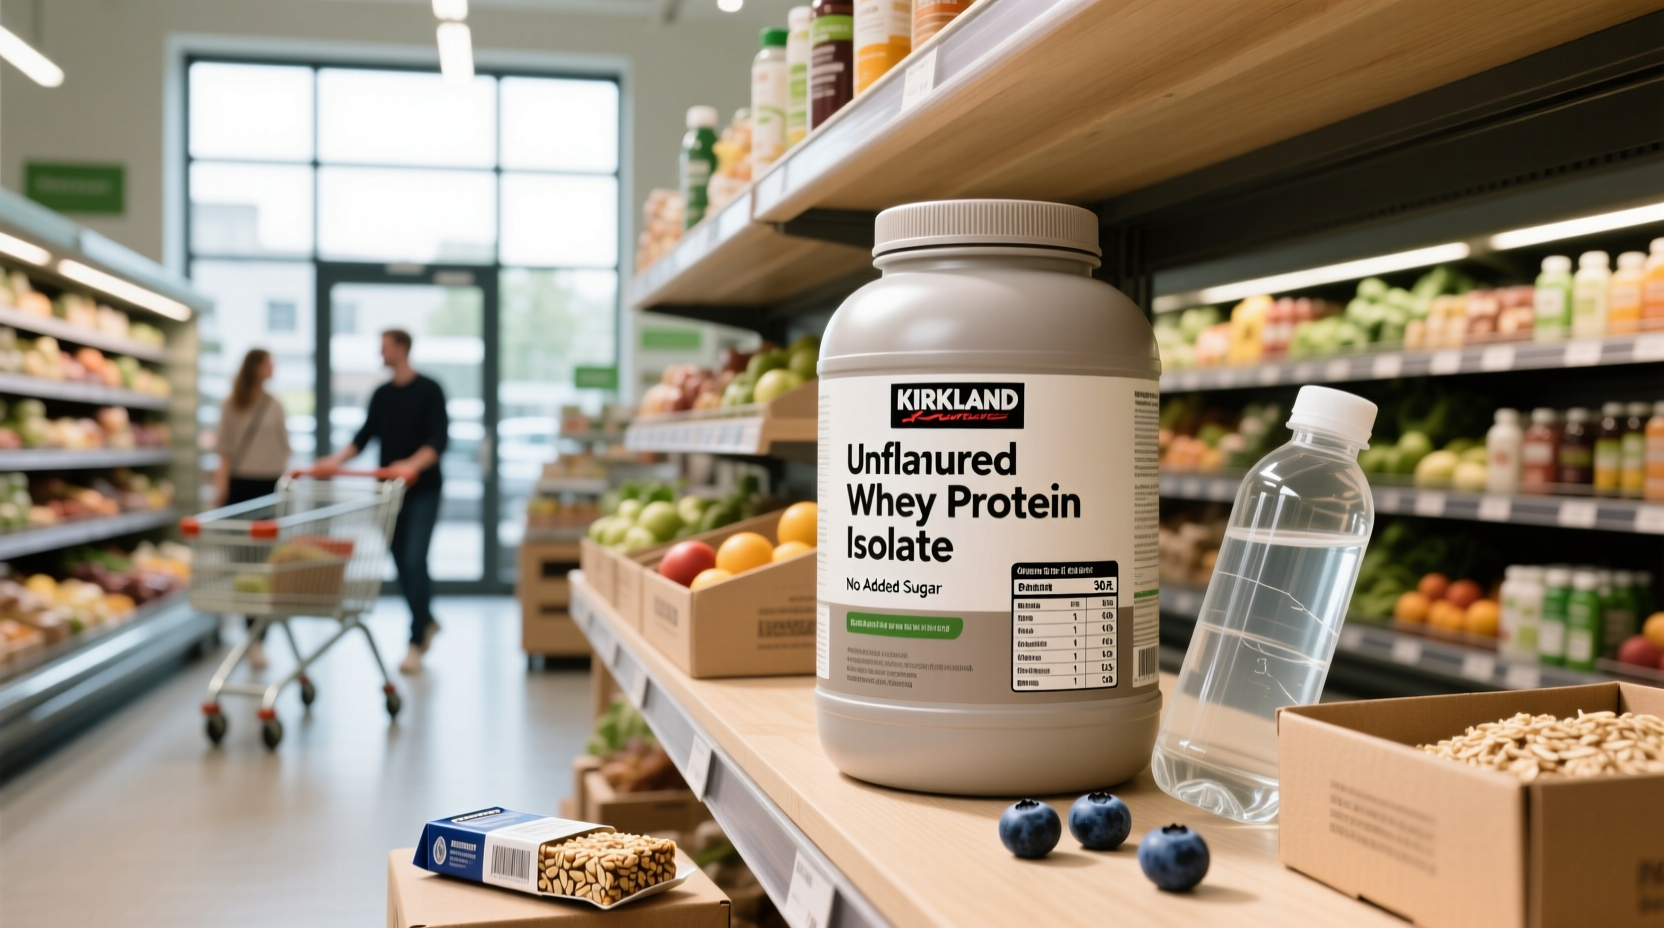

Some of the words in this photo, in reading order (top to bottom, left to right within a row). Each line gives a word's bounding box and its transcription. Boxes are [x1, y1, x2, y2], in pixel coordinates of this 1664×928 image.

[898, 389, 1018, 410] KIRKLAND
[847, 482, 937, 527] Whey
[948, 482, 1081, 519] Protein
[847, 526, 954, 562] Isolate
[846, 577, 860, 591] No
[863, 578, 900, 593] Added
[903, 580, 942, 598] Sugar
